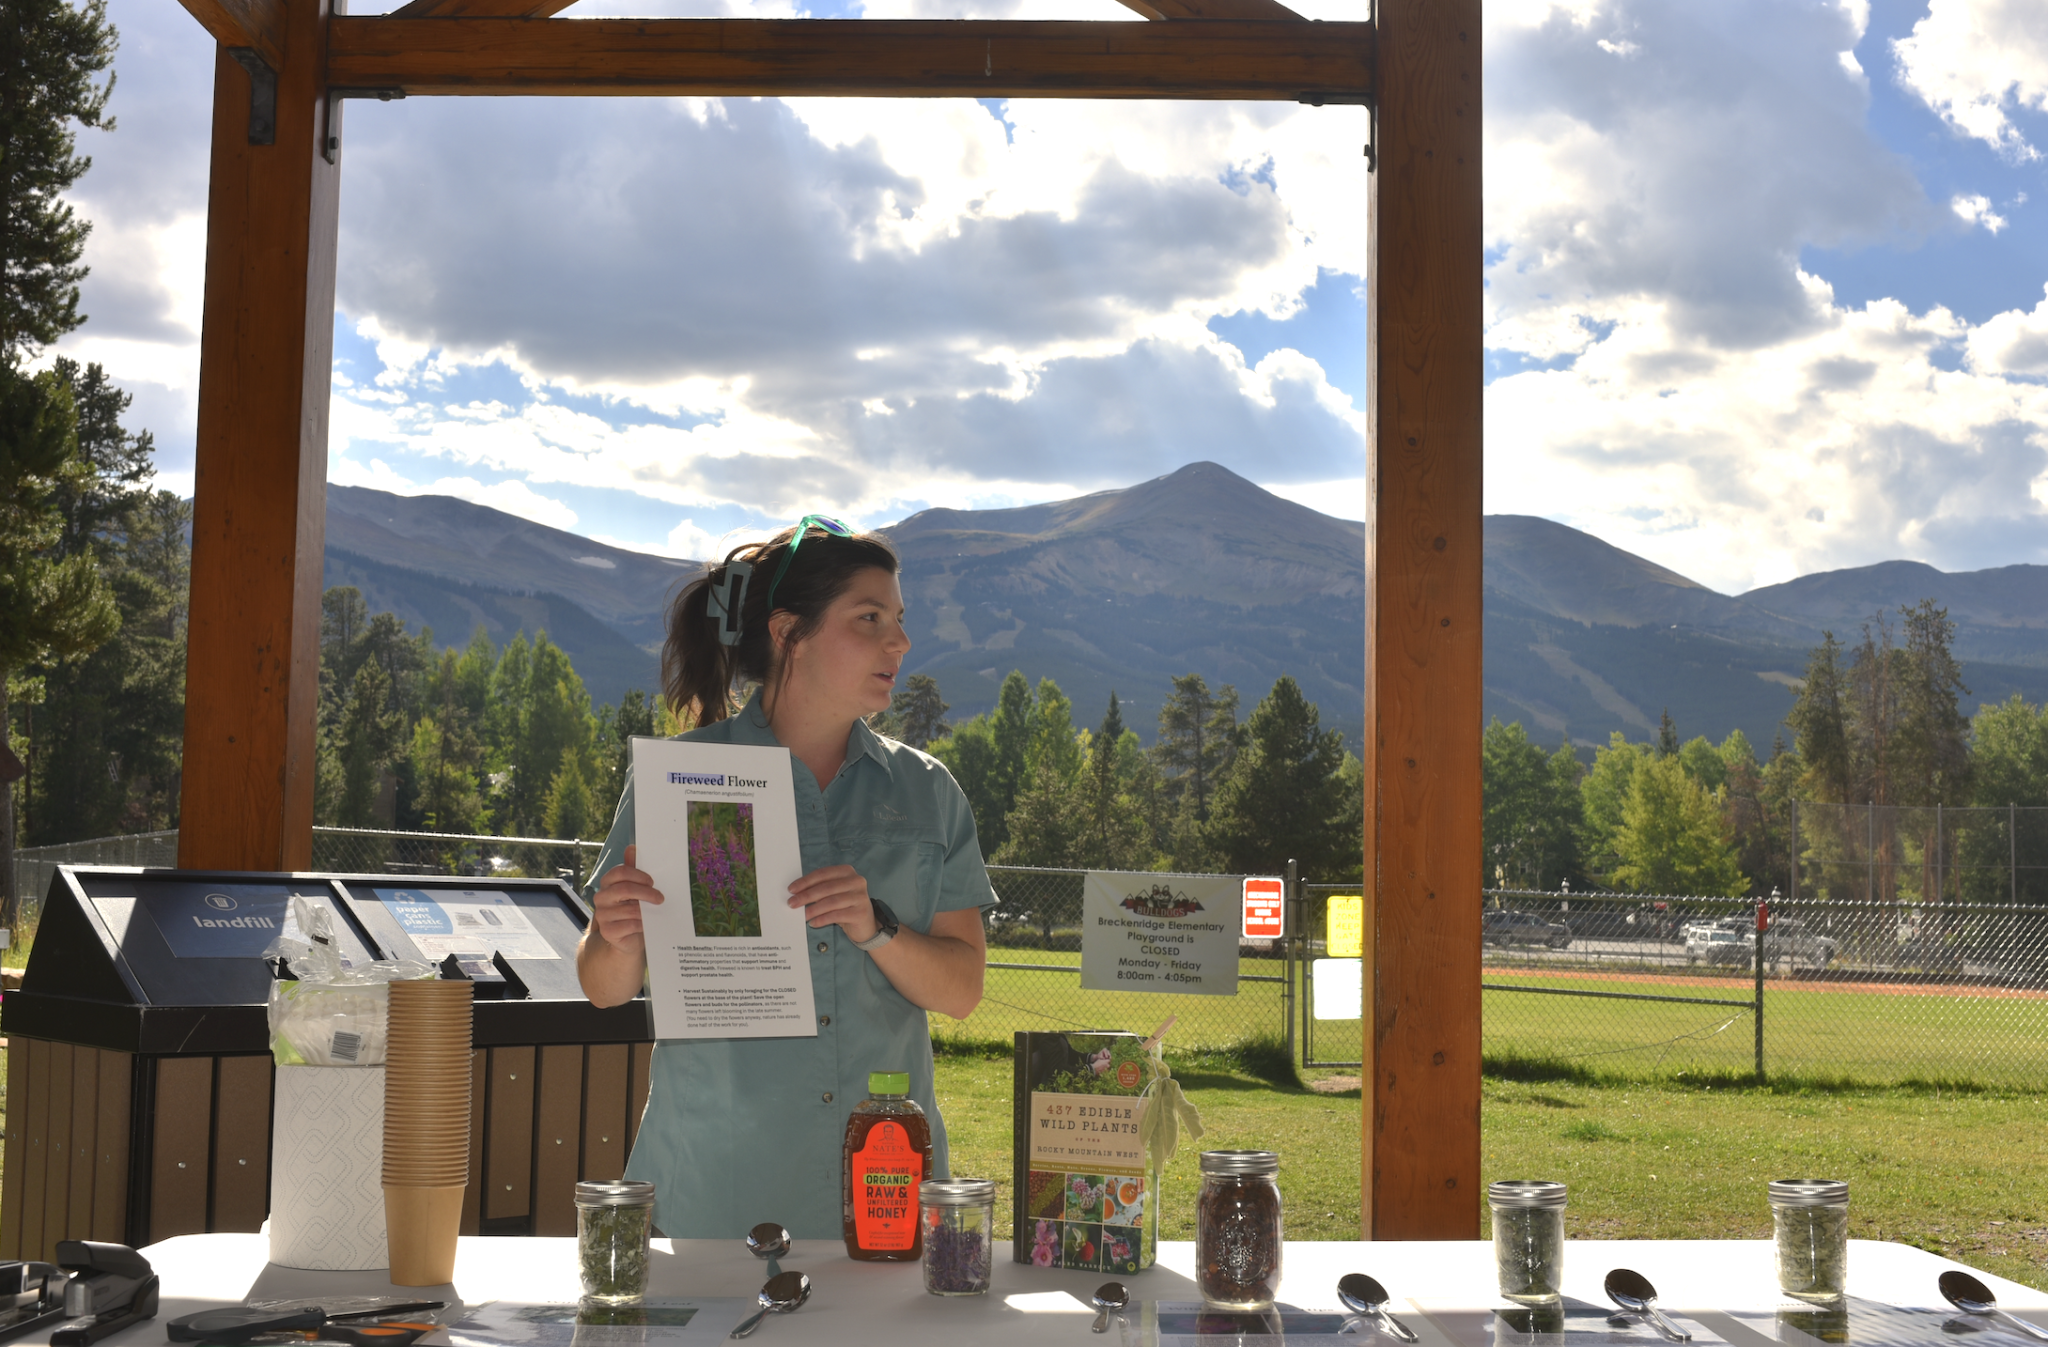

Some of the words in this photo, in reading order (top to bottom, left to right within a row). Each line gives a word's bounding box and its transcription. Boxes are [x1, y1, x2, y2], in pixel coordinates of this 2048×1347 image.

[671, 773, 724, 786] Fireweed
[728, 776, 767, 787] Flower
[1137, 906, 1185, 917] BULLDOGS
[192, 916, 275, 928] landfill
[404, 917, 443, 926] plastic
[1098, 917, 1164, 931] Breckenridge
[1168, 921, 1224, 933] Elementary
[1336, 922, 1360, 930] KEEP
[1128, 932, 1184, 943] Playground
[1187, 934, 1194, 943] is
[1141, 945, 1180, 956] CLOSED
[1118, 958, 1161, 969] Monday
[1171, 961, 1201, 971] Friday
[1117, 971, 1154, 980] 8:00am
[1165, 973, 1201, 984] 4:05pm
[1046, 1105, 1072, 1115] 437
[1079, 1106, 1131, 1119] EDIBLE
[1040, 1119, 1075, 1130] WILD
[1082, 1122, 1138, 1134] PLANTS
[1037, 1146, 1065, 1154] ROCKY
[1068, 1148, 1112, 1157] MOUNTAIN
[1116, 1150, 1139, 1158] WEST
[866, 1175, 909, 1184] ORGANIC
[867, 1186, 896, 1198] RAW
[868, 1207, 907, 1218] HONEY
